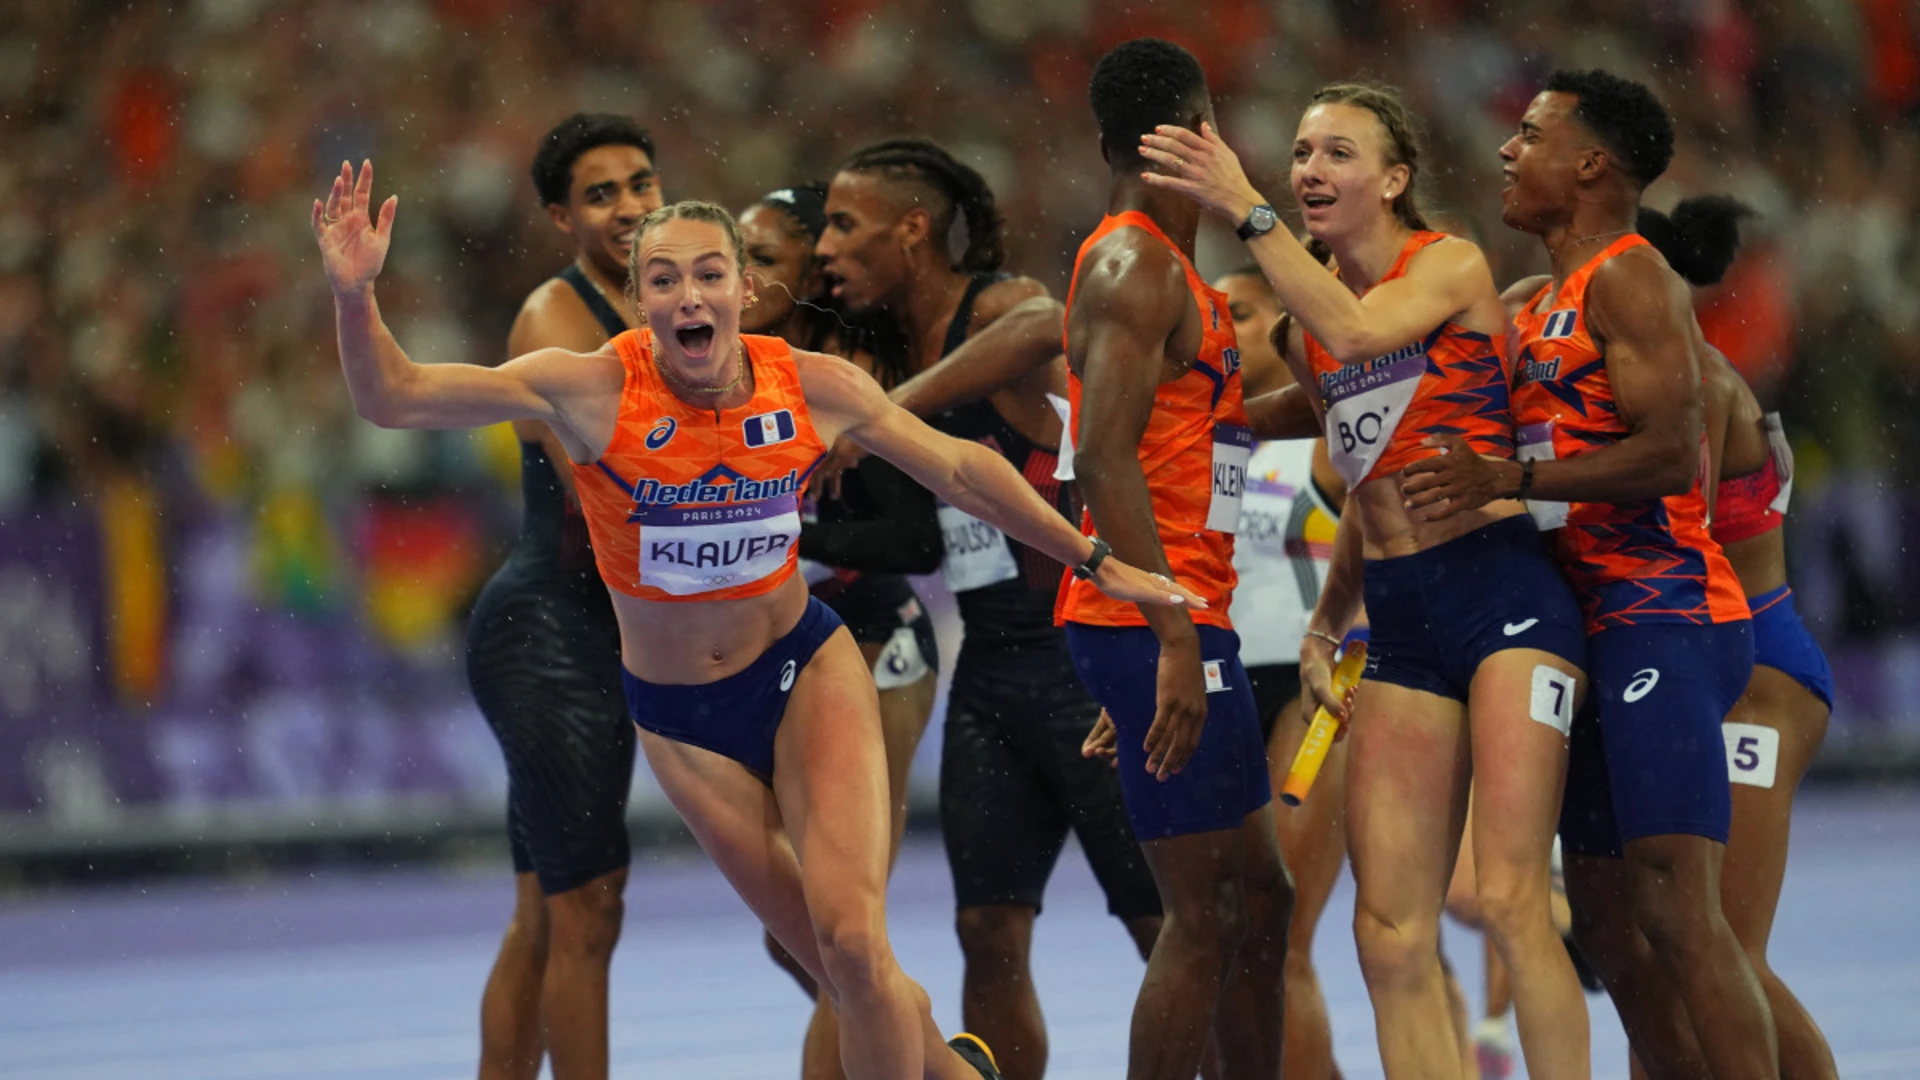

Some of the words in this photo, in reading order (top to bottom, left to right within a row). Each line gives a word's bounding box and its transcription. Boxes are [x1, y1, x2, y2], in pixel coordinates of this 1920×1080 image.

[1361, 372, 1391, 388] 2024
[1338, 406, 1389, 453] BO
[632, 469, 797, 504] Nederland
[683, 510, 723, 522] PARIS
[727, 507, 762, 519] 2024
[651, 534, 789, 569] KLAVER
[1549, 679, 1566, 717] 7
[1733, 736, 1760, 771] 5
